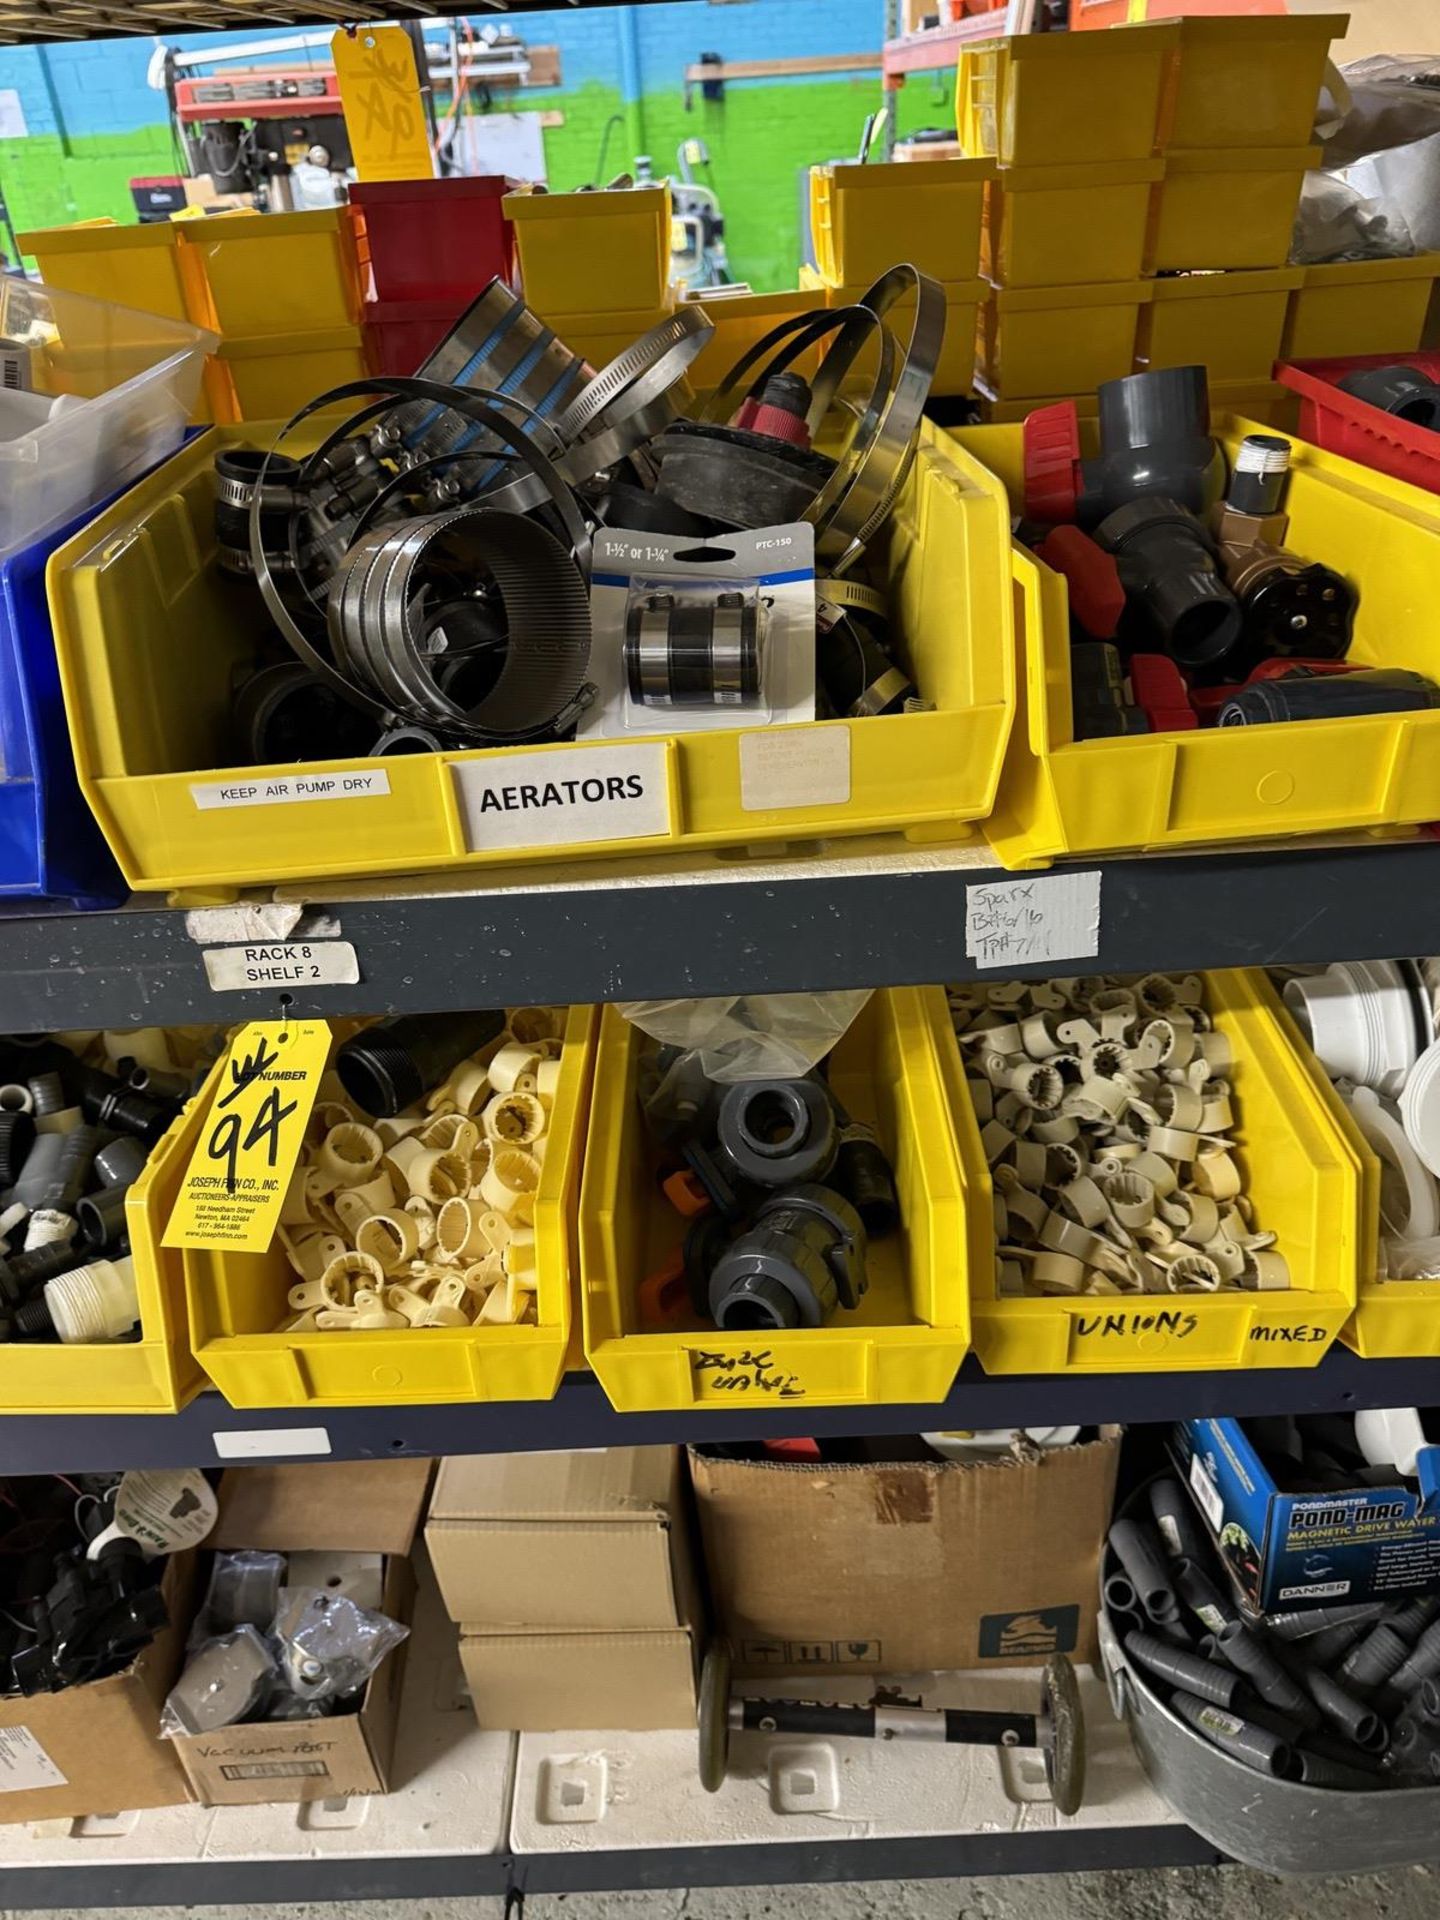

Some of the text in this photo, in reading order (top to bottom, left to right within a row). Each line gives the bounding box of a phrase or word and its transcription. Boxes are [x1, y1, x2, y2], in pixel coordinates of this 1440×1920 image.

[756, 537, 792, 550] PTC-150
[630, 548, 643, 560] or
[220, 777, 372, 800] KEEP AIR PUMP DRY
[480, 774, 644, 813] AERATORS
[245, 946, 312, 961] RACK 8
[247, 965, 321, 981] SHELF 2
[259, 1071, 307, 1081] NUMBER
[208, 1086, 298, 1194] 94
[187, 1176, 221, 1188] JOSEPH
[243, 1178, 260, 1191] CO.,
[262, 1179, 280, 1191] INC.
[236, 1206, 256, 1214] Street
[1078, 1310, 1327, 1342] UNIONS MIXED
[1292, 1498, 1368, 1510] PONDMASTER
[1288, 1502, 1405, 1530] POND-MAG
[1287, 1526, 1351, 1540] MAGNETIC
[1355, 1522, 1391, 1533] DRIVE
[1394, 1516, 1436, 1529] WATER
[1282, 1583, 1348, 1598] DANNER
